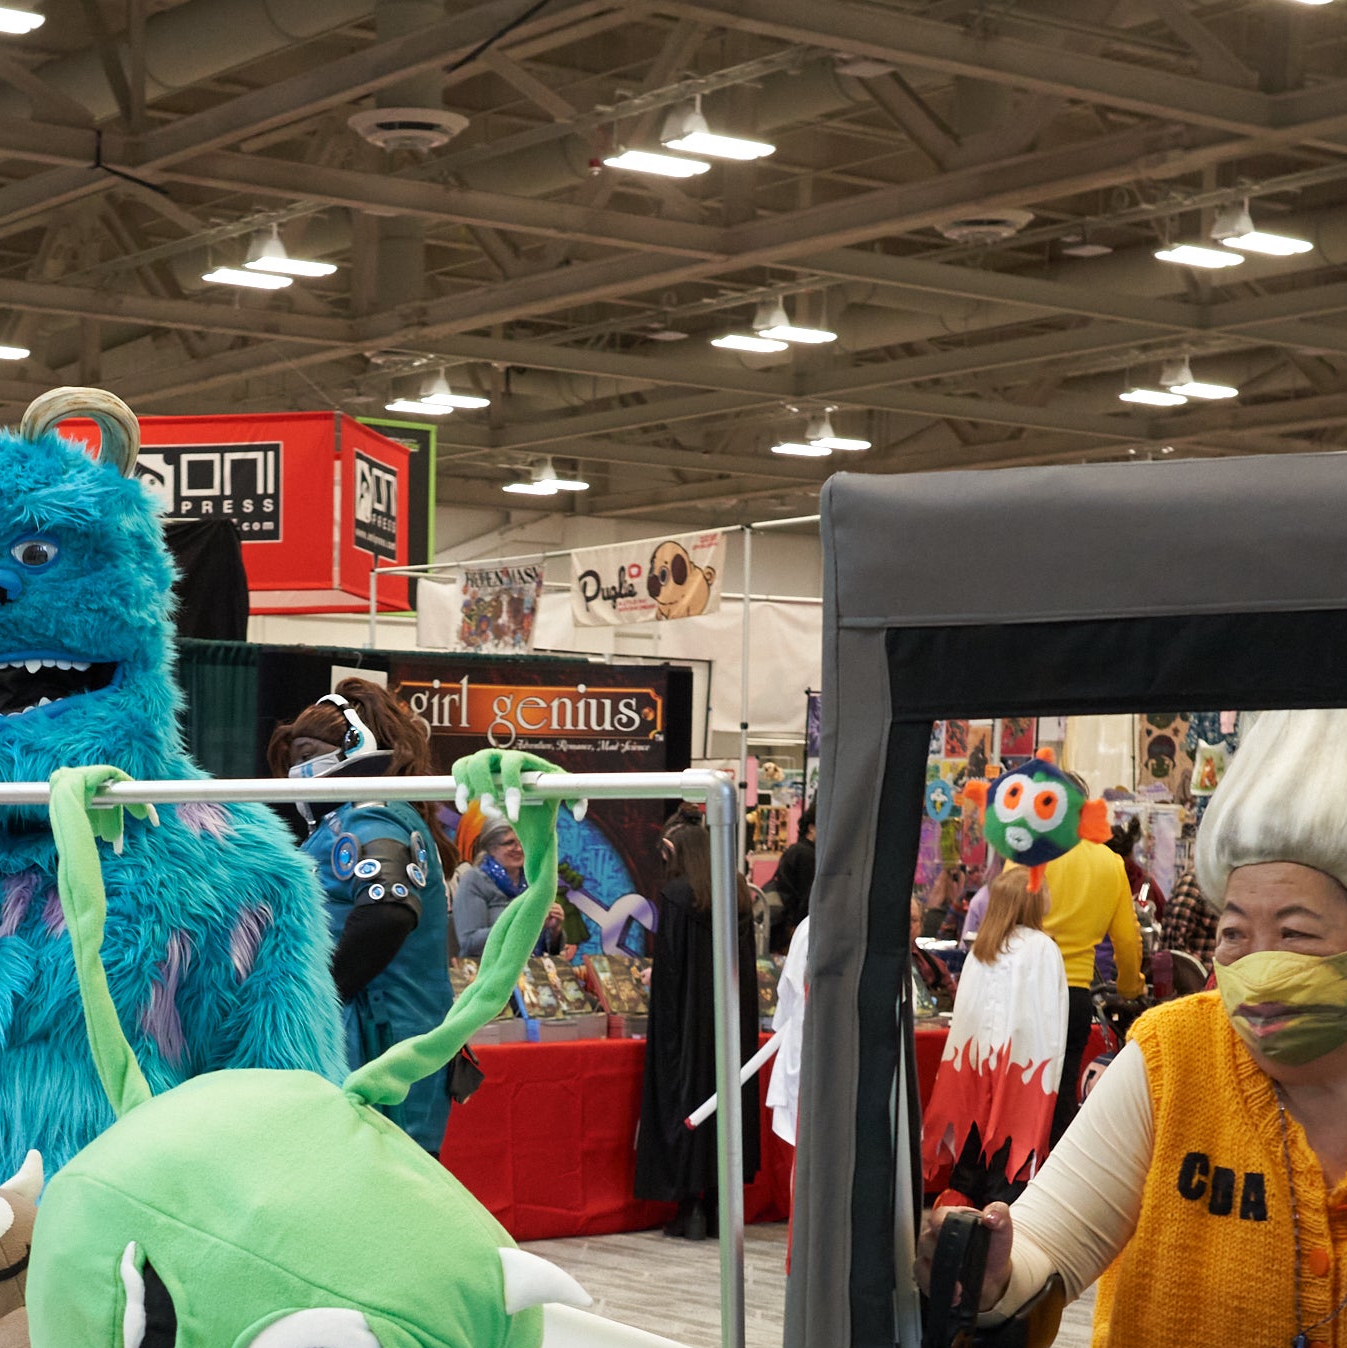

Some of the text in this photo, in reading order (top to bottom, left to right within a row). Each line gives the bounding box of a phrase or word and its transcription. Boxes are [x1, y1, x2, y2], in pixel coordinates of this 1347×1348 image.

[181, 498, 275, 515] PRESS
[372, 513, 397, 535] PRESS
[410, 674, 641, 749] girl genius
[1177, 1151, 1268, 1222] CDA
